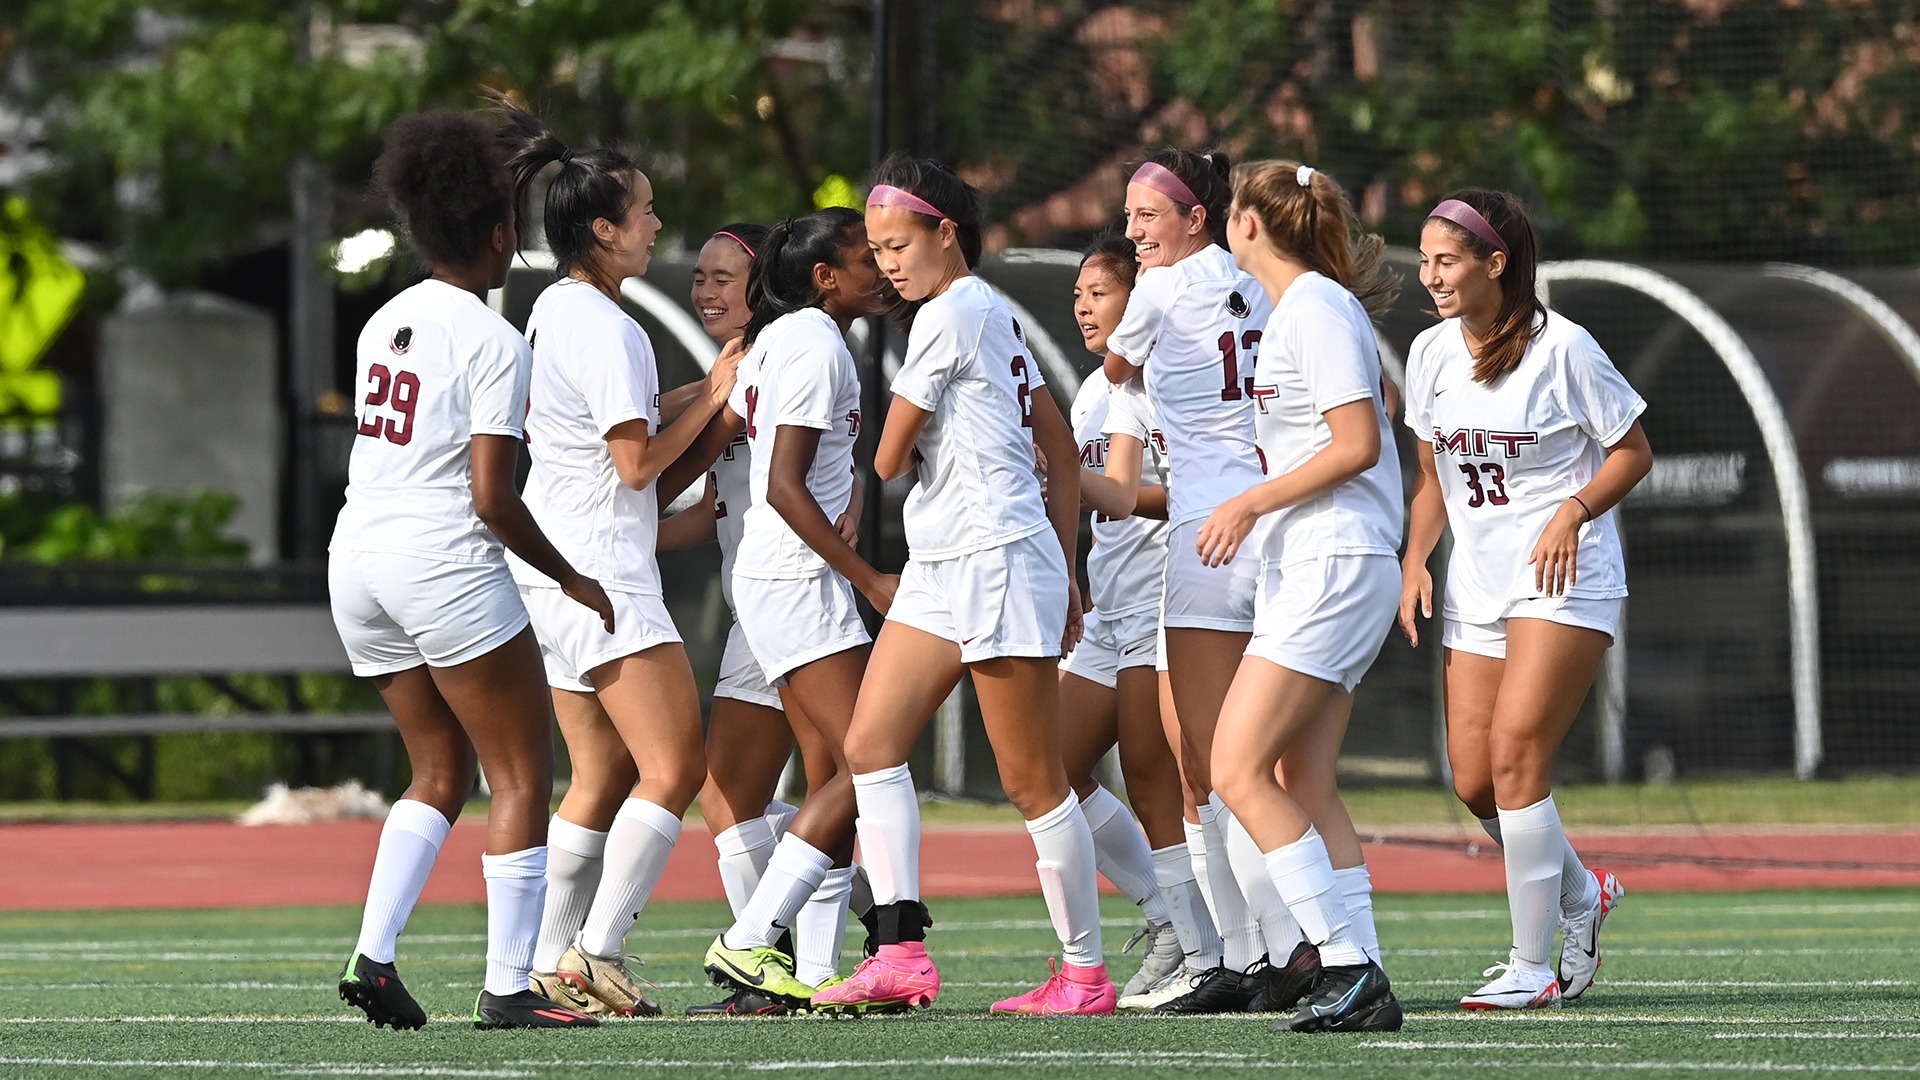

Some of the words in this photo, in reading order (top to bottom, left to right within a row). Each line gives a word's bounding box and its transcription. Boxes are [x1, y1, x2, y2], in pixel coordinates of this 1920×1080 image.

[358, 363, 421, 446] 29
[1433, 427, 1538, 459] MIT
[1459, 463, 1510, 508] 33
